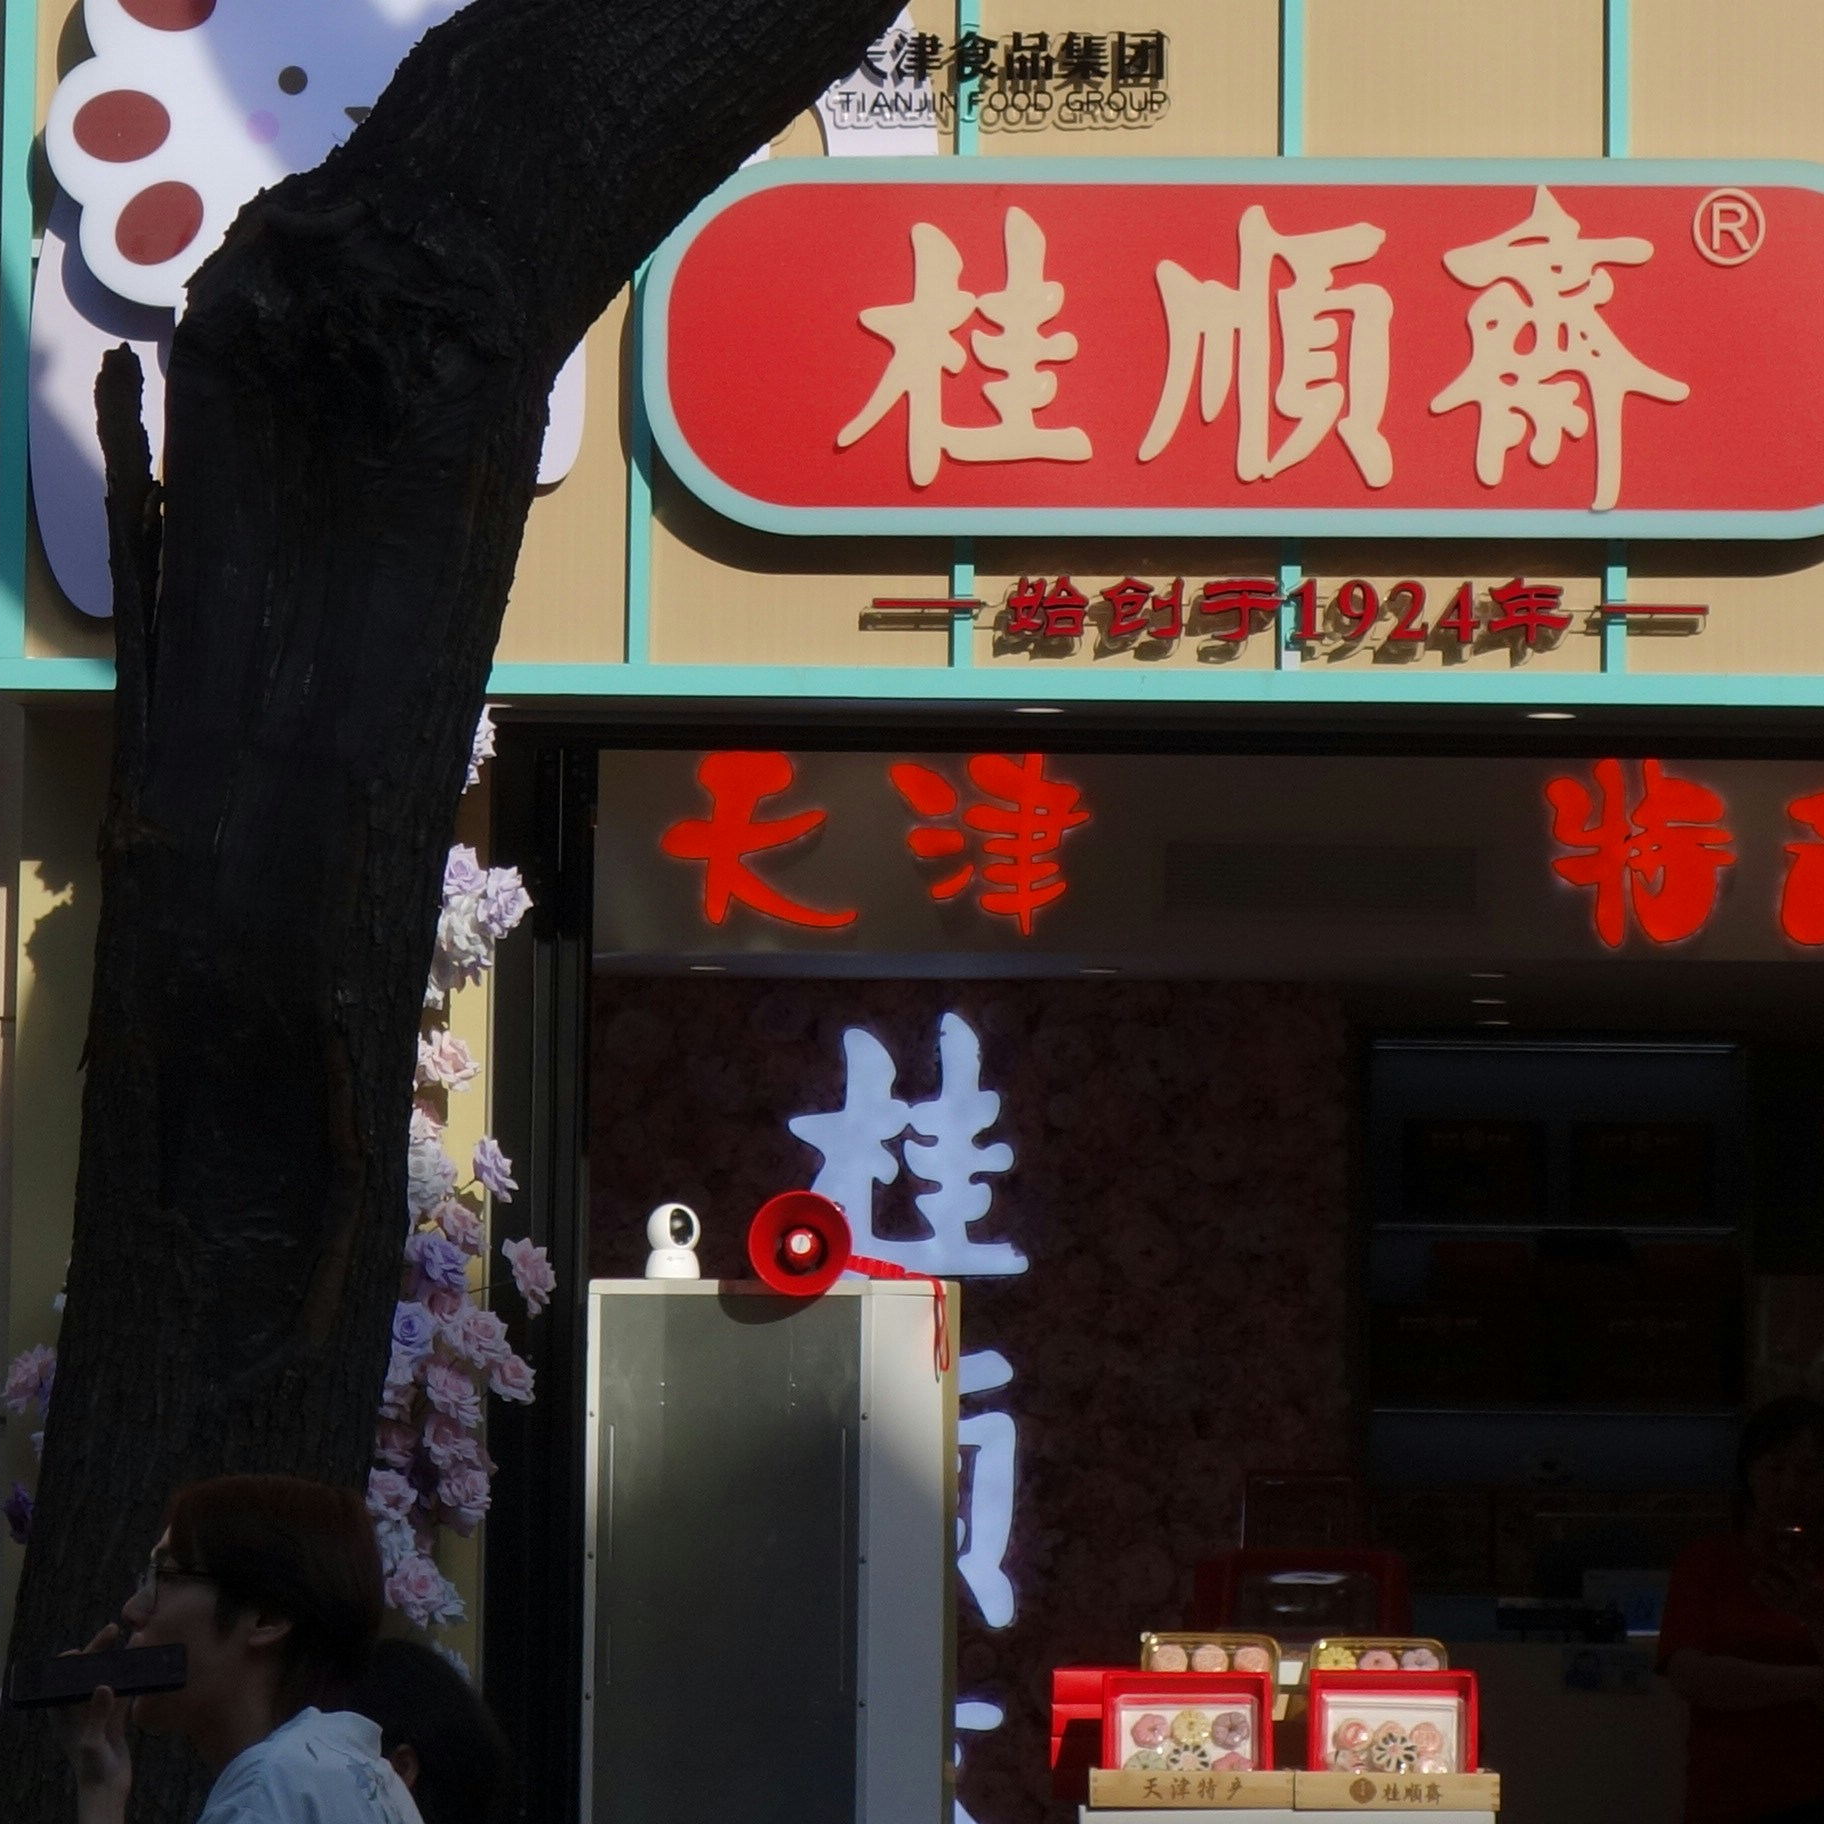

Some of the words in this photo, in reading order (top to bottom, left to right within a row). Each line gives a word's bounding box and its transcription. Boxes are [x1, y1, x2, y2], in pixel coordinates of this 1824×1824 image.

[836, 89, 958, 114] TIANJIN
[967, 89, 1054, 114] FOOD
[1066, 89, 1168, 114] GROUP
[1006, 576, 1573, 645] 始创于1924年
